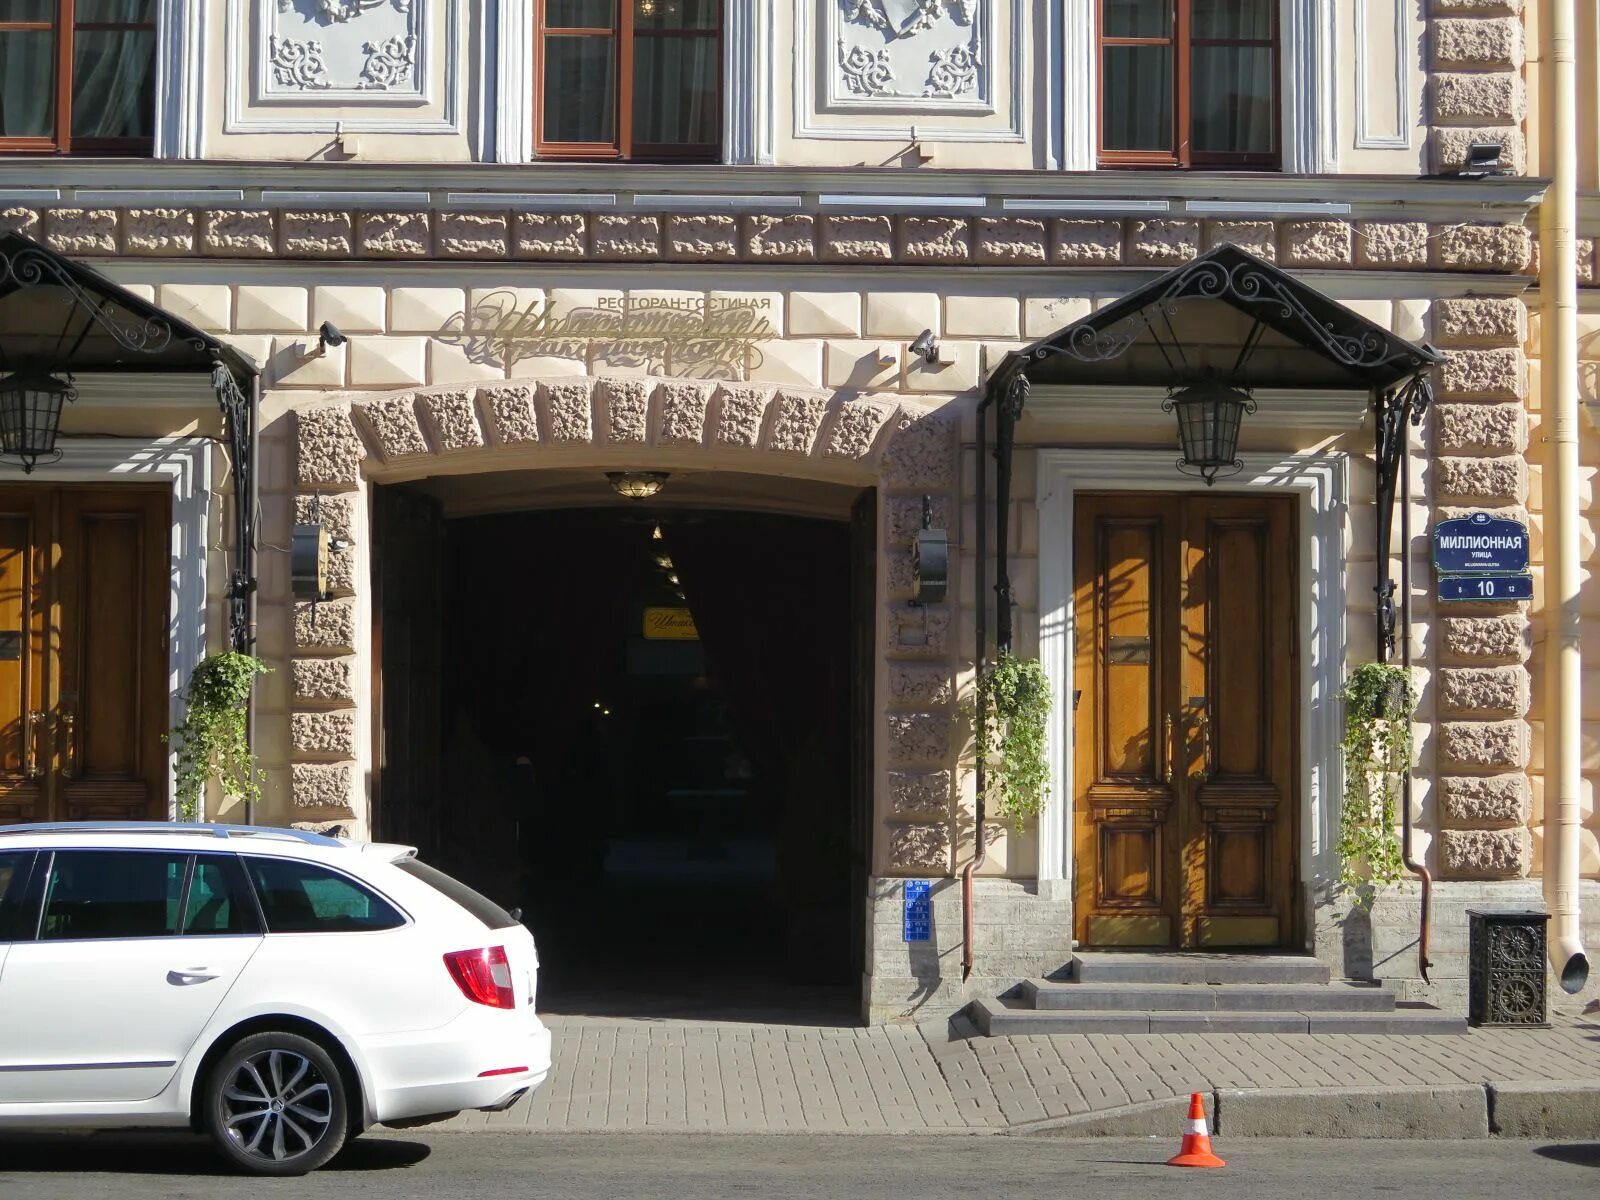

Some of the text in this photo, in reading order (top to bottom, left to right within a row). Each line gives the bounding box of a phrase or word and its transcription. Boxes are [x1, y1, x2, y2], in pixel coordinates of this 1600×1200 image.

[597, 297, 771, 309] РЕСТОРАН-ГОСТИНАЯ
[1440, 536, 1522, 549] МИЛЛИОННАЯ
[1471, 551, 1492, 559] УЛИЦА
[1477, 581, 1495, 596] 10
